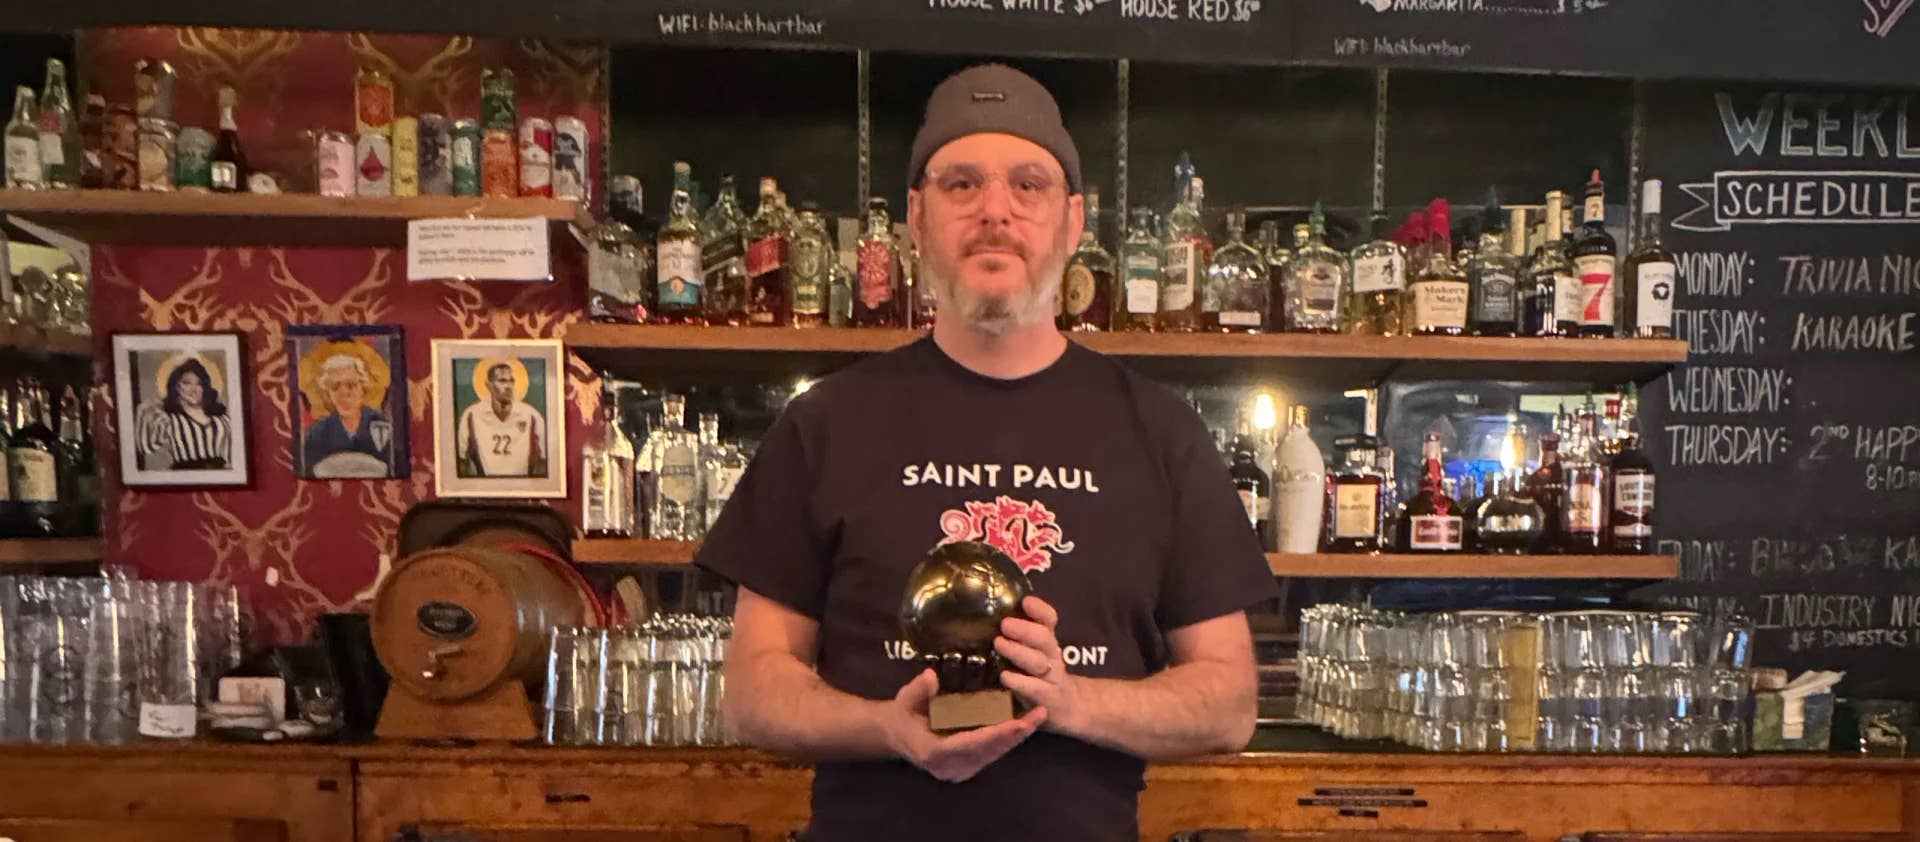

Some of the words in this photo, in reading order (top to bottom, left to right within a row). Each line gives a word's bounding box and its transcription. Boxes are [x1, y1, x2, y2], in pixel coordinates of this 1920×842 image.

[1187, 0, 1230, 22] RED
[1722, 180, 1920, 217] SCHEDULE
[1779, 256, 1872, 296] TRIVIA
[1579, 273, 1613, 322] 7
[1791, 312, 1917, 351] KARAOKE
[1667, 366, 1794, 414] WEDNESDAY:
[491, 433, 512, 456] 22
[1664, 424, 1793, 467] THURSDAY:
[1854, 424, 1920, 461] HAPP
[902, 460, 1001, 488] SAINT
[1012, 464, 1100, 493] PAUL
